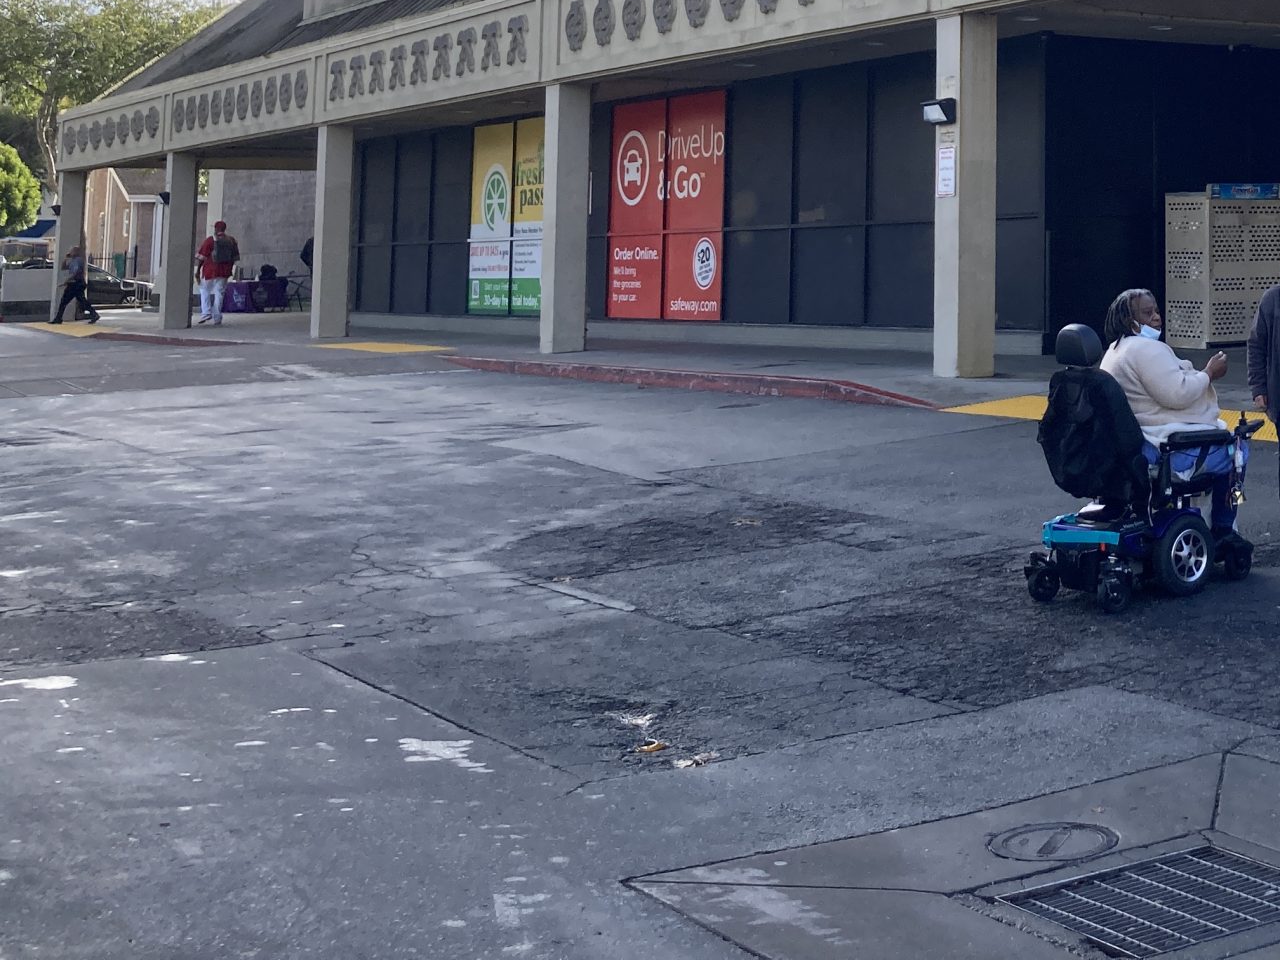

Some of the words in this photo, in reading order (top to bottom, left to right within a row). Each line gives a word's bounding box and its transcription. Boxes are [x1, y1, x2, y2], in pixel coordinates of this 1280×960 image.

[658, 123, 725, 165] DriveUp
[614, 247, 634, 260] Order
[634, 246, 659, 260] Online.
[697, 246, 711, 265] $20
[670, 297, 717, 315] safeway.com
